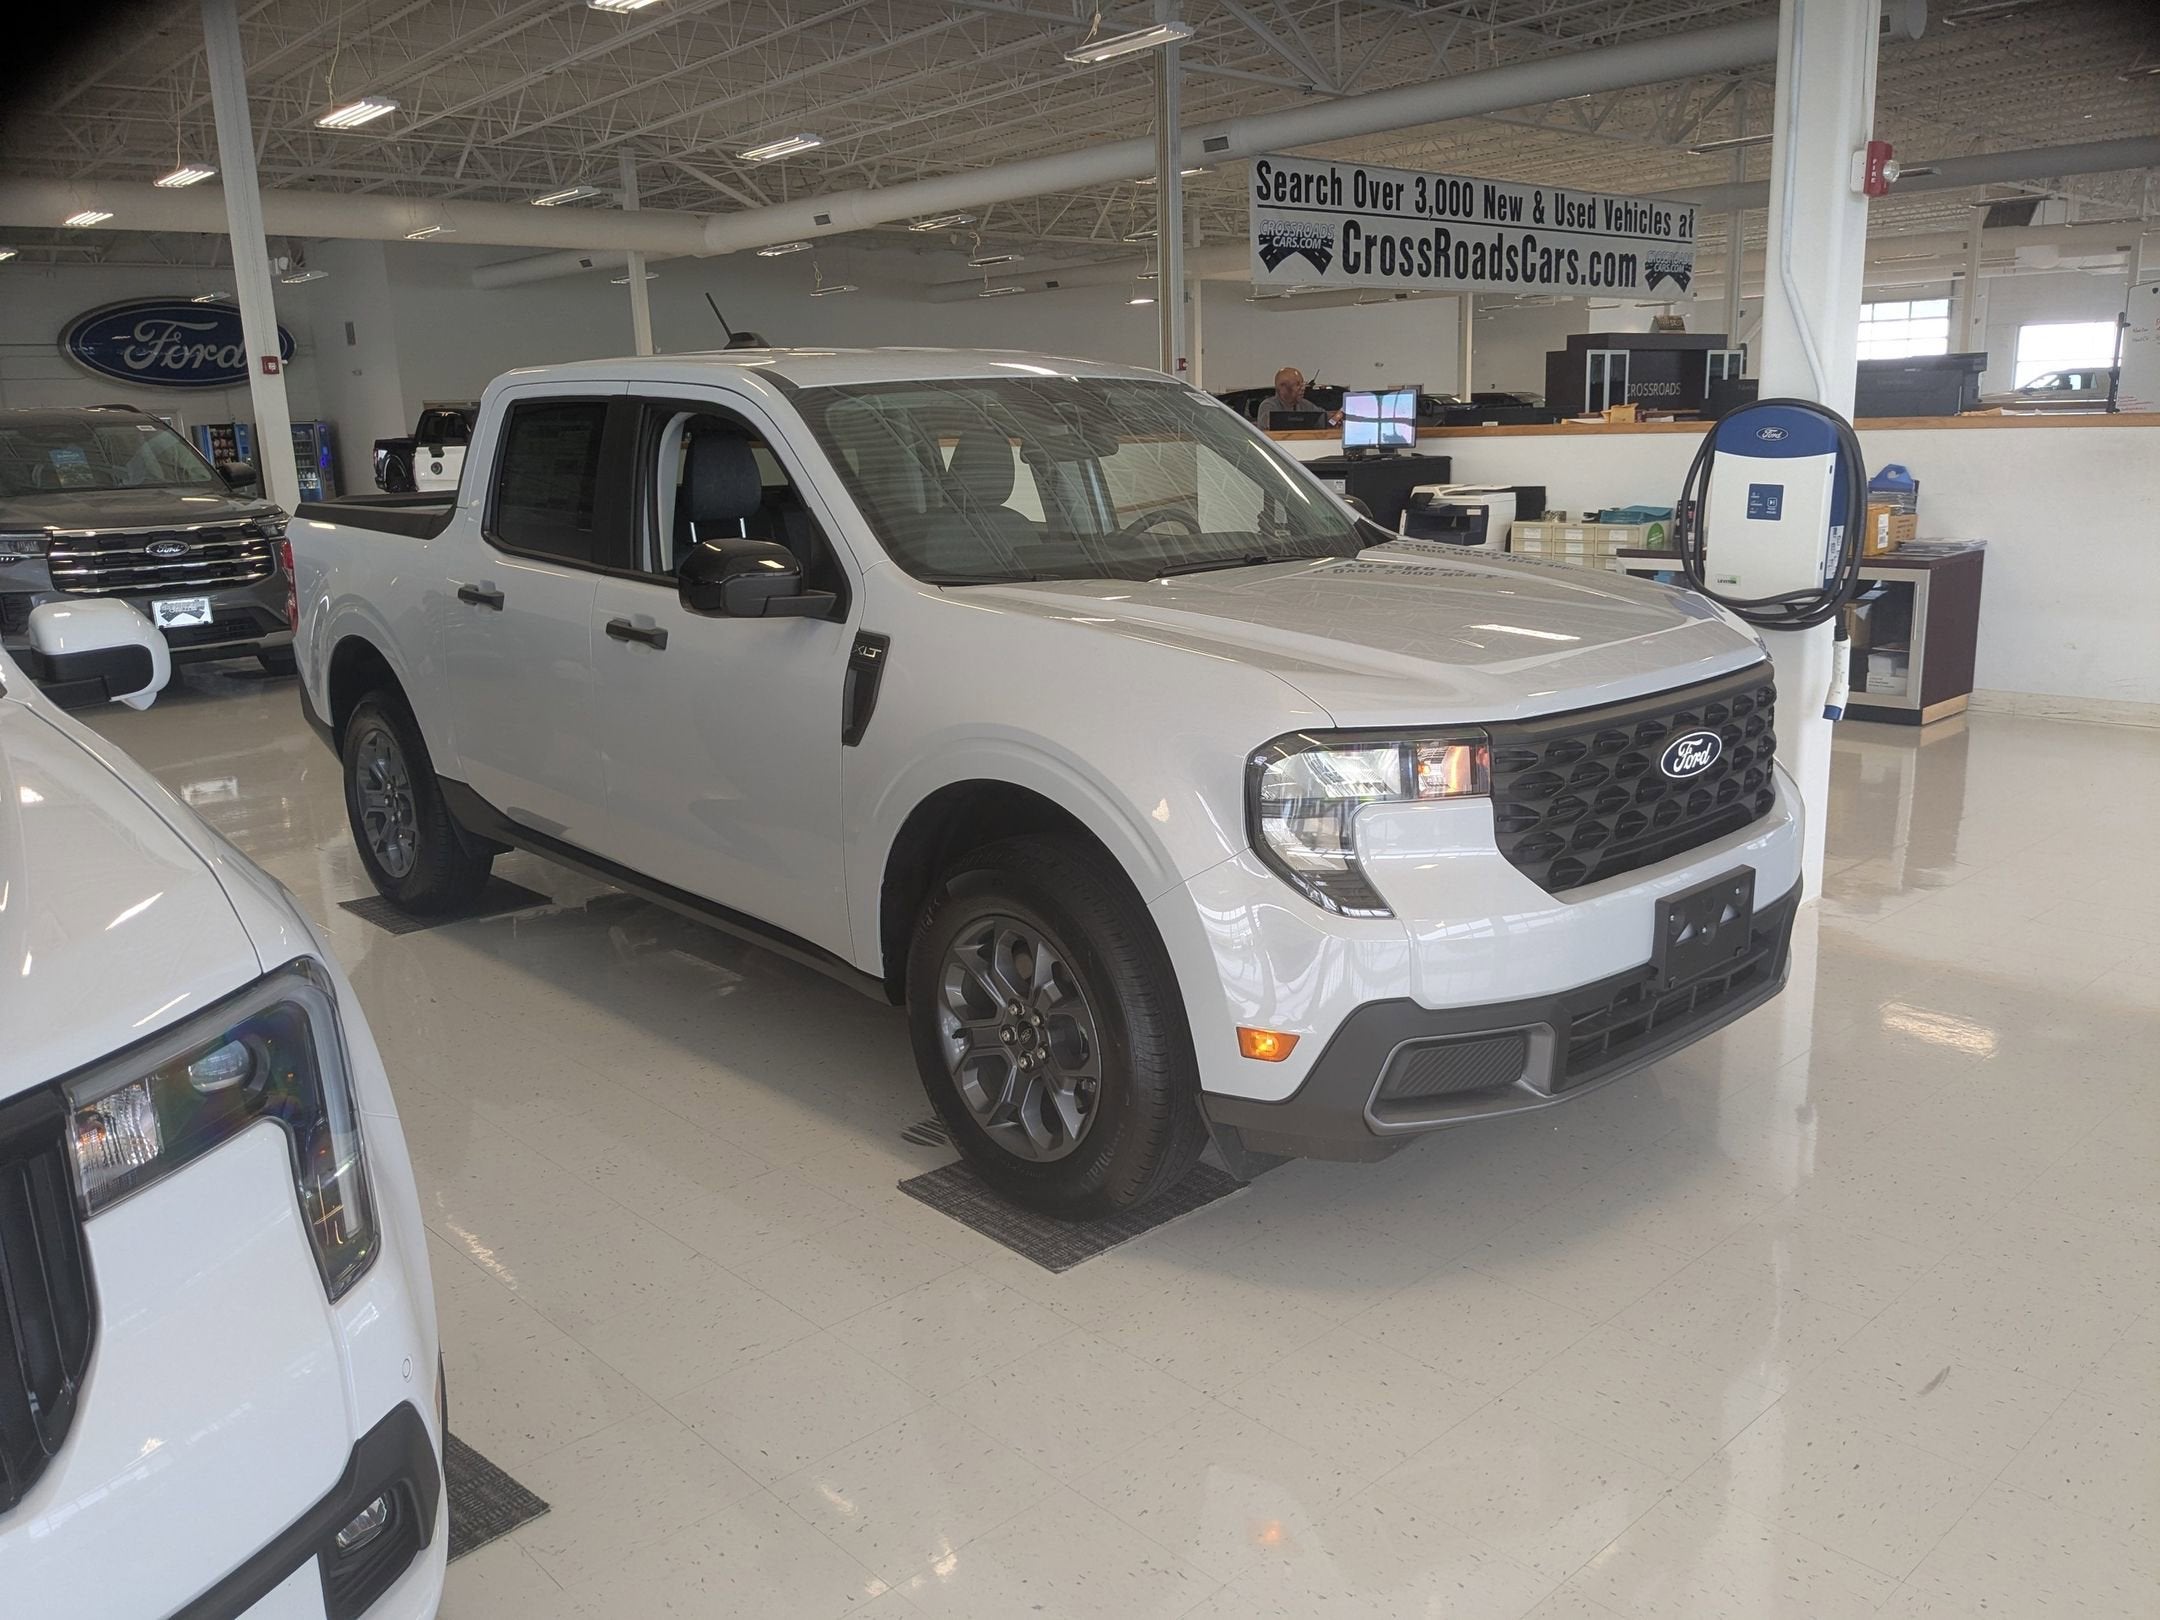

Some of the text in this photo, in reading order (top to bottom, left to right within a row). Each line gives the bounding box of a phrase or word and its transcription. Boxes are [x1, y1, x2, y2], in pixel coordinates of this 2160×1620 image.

[1256, 160, 1694, 238] Search Over 3,000 New & Used Vehicles at
[1259, 220, 1336, 240] CROSSROADS
[1272, 235, 1322, 249] CARS.COM
[1342, 219, 1637, 288] CrossRoadsCars.com
[1625, 382, 1682, 397] CROSSROADS
[1761, 428, 1783, 439] Ford
[156, 543, 183, 553] Ford
[852, 643, 882, 658] XLT
[1673, 738, 1712, 773] Ford
